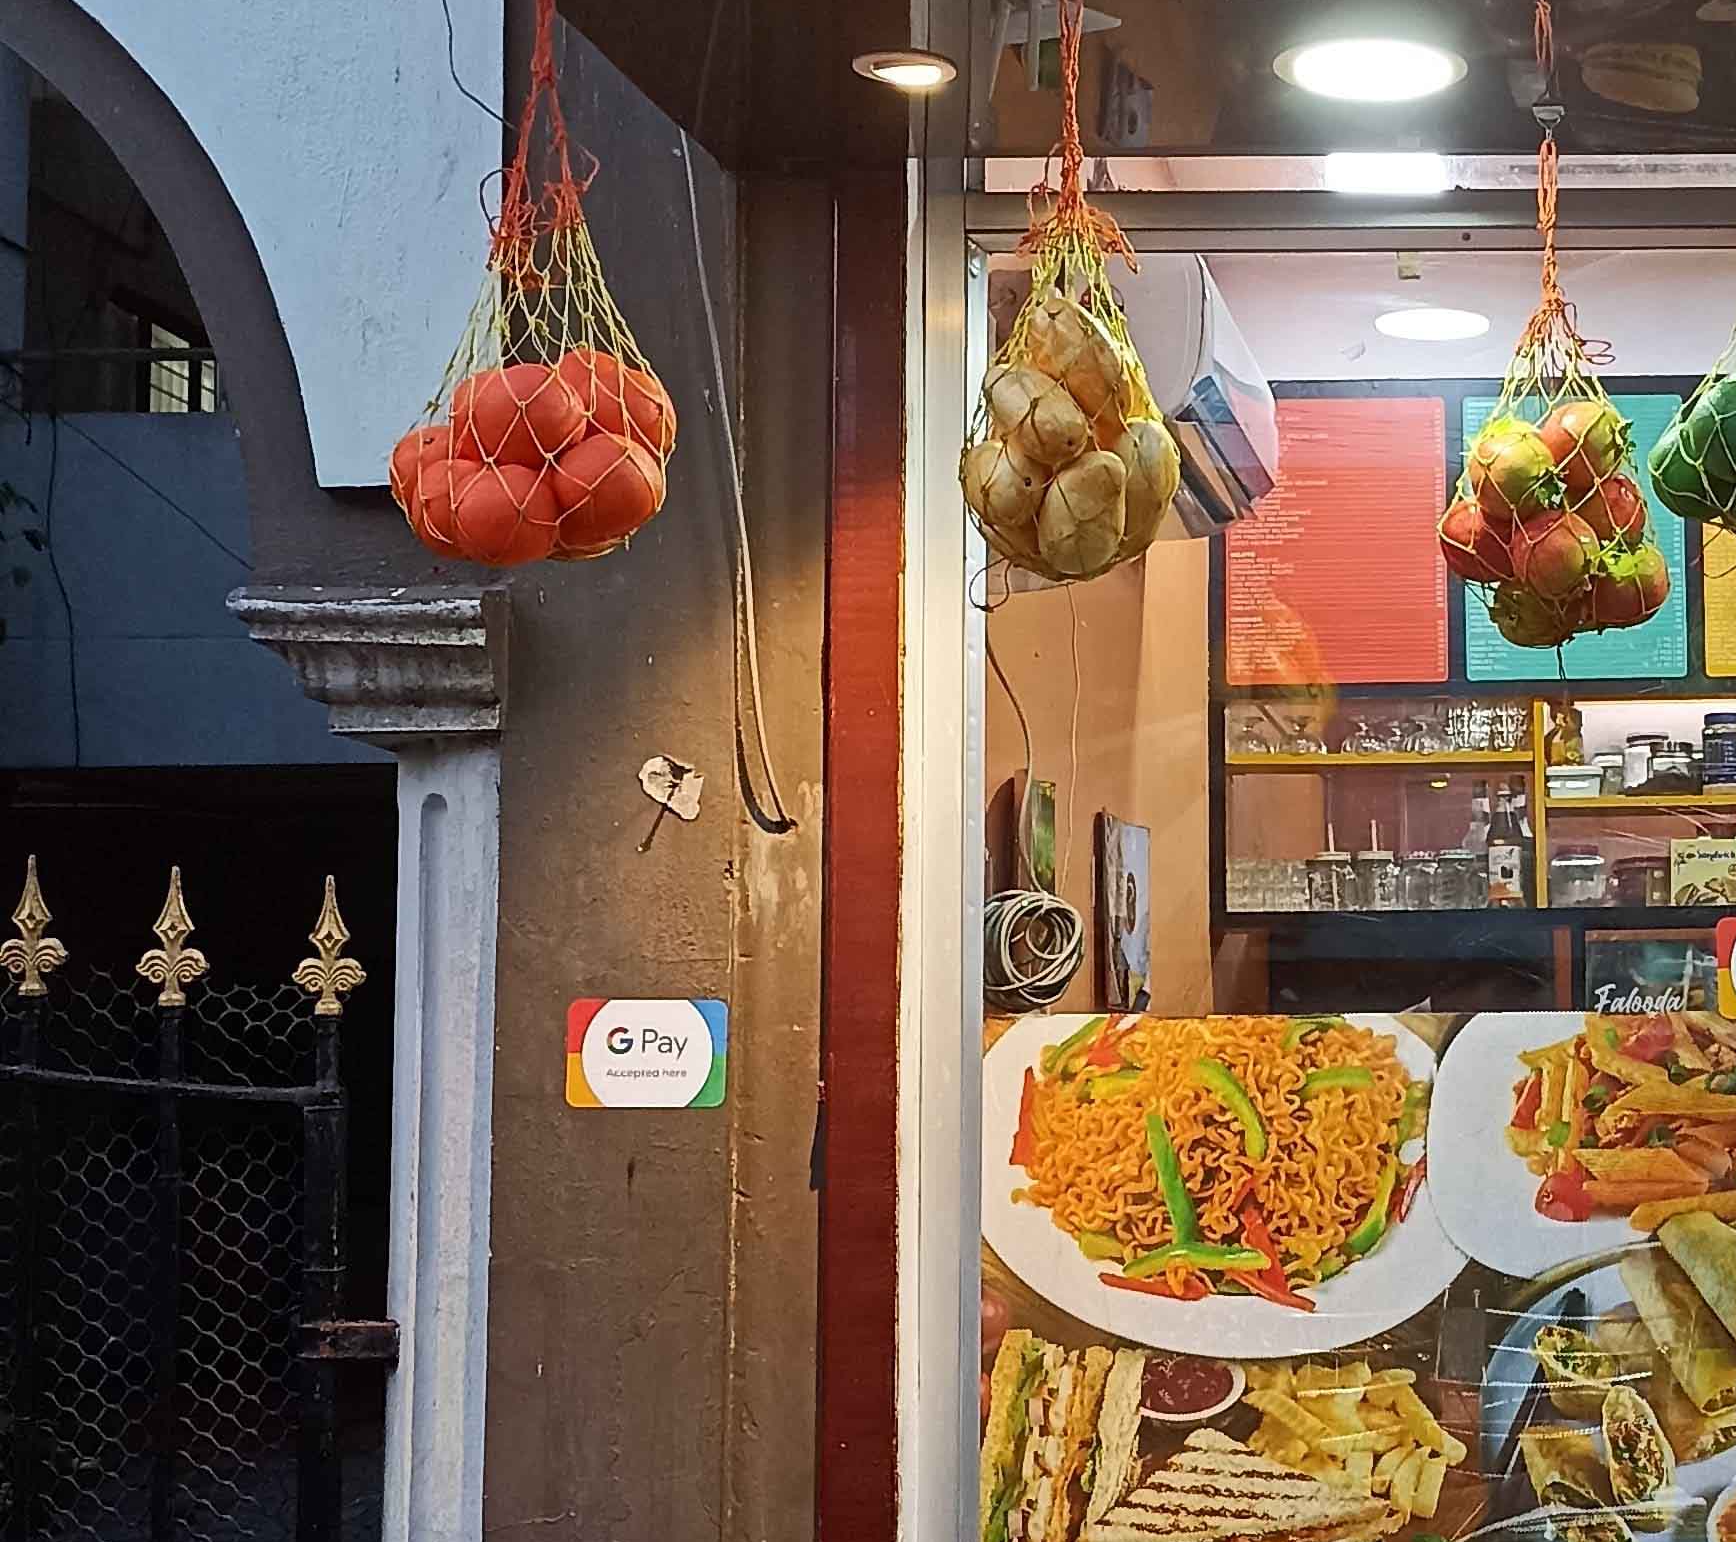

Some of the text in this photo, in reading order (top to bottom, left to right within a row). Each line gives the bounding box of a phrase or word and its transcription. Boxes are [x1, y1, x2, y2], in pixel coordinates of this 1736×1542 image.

[1593, 982, 1684, 1013] Falooda
[606, 1026, 688, 1061] G Pay
[606, 1068, 687, 1080] Accepted here
